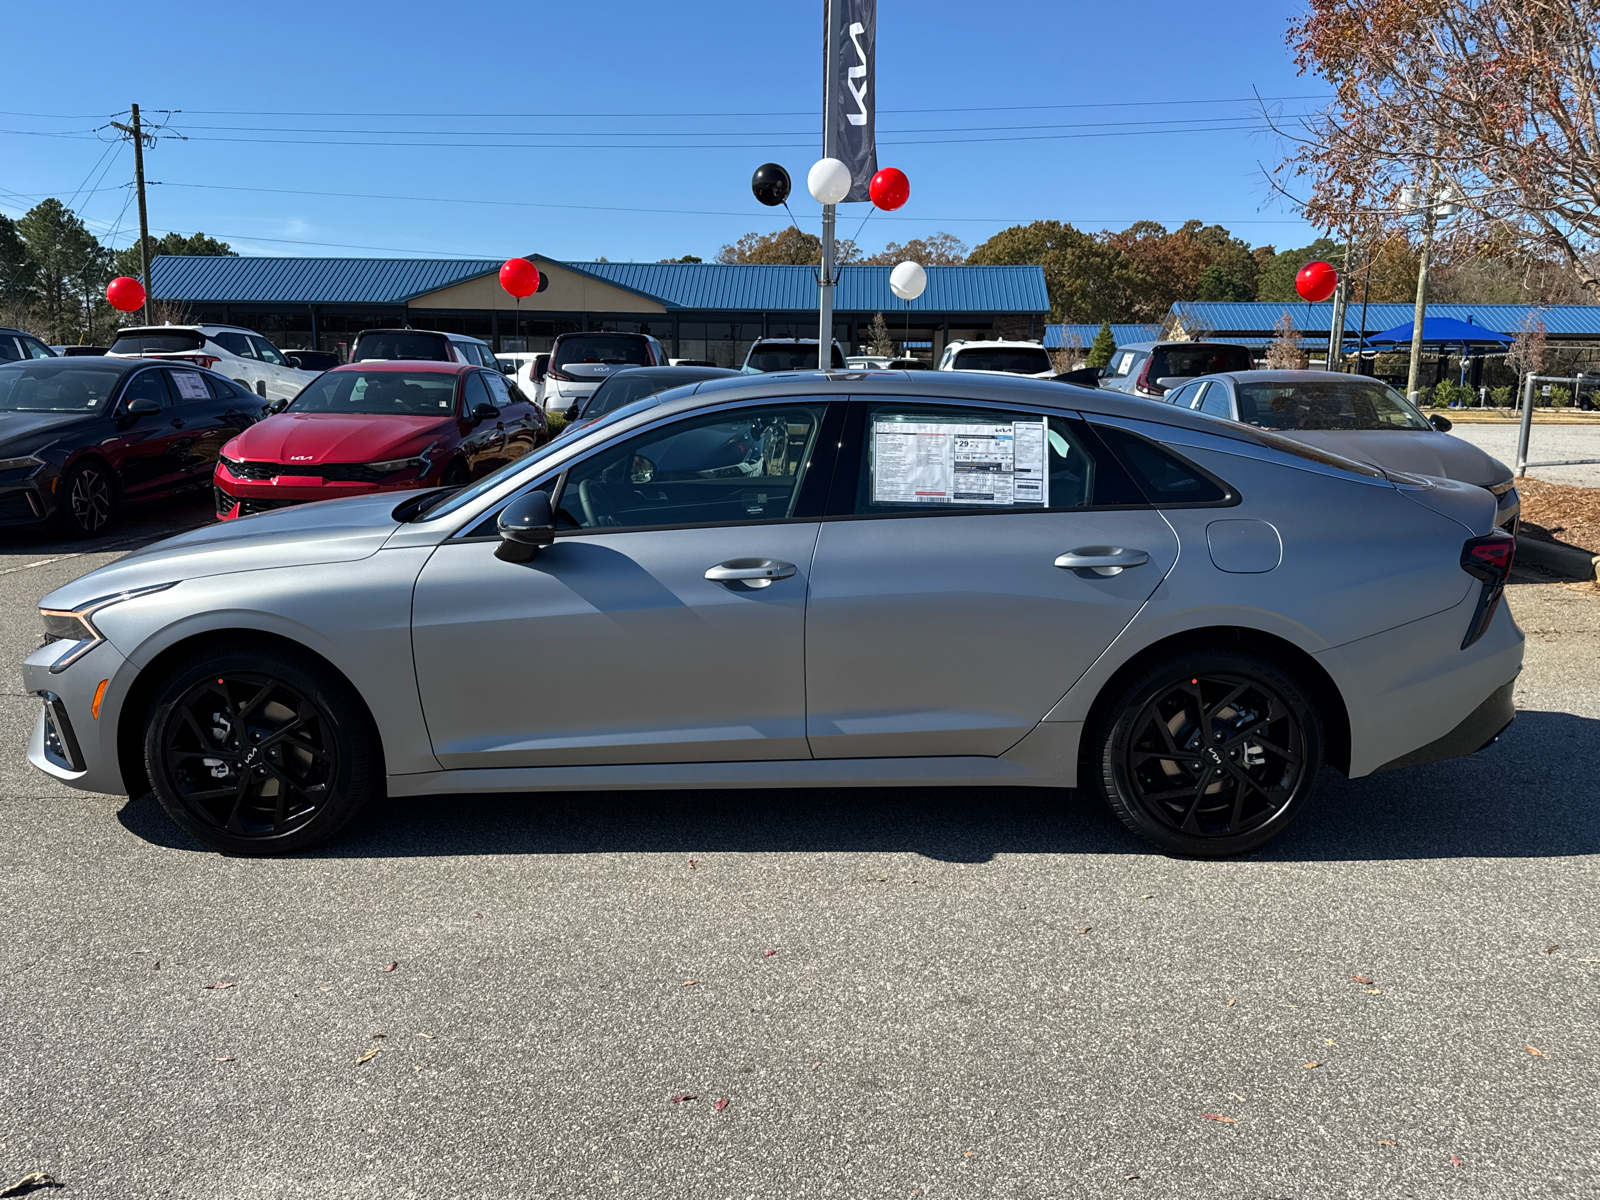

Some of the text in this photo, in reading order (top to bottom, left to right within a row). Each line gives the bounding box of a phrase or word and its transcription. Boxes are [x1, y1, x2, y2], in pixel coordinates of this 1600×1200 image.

[846, 22, 867, 125] KIA
[244, 747, 258, 764] KIA
[1208, 747, 1222, 764] KIA
